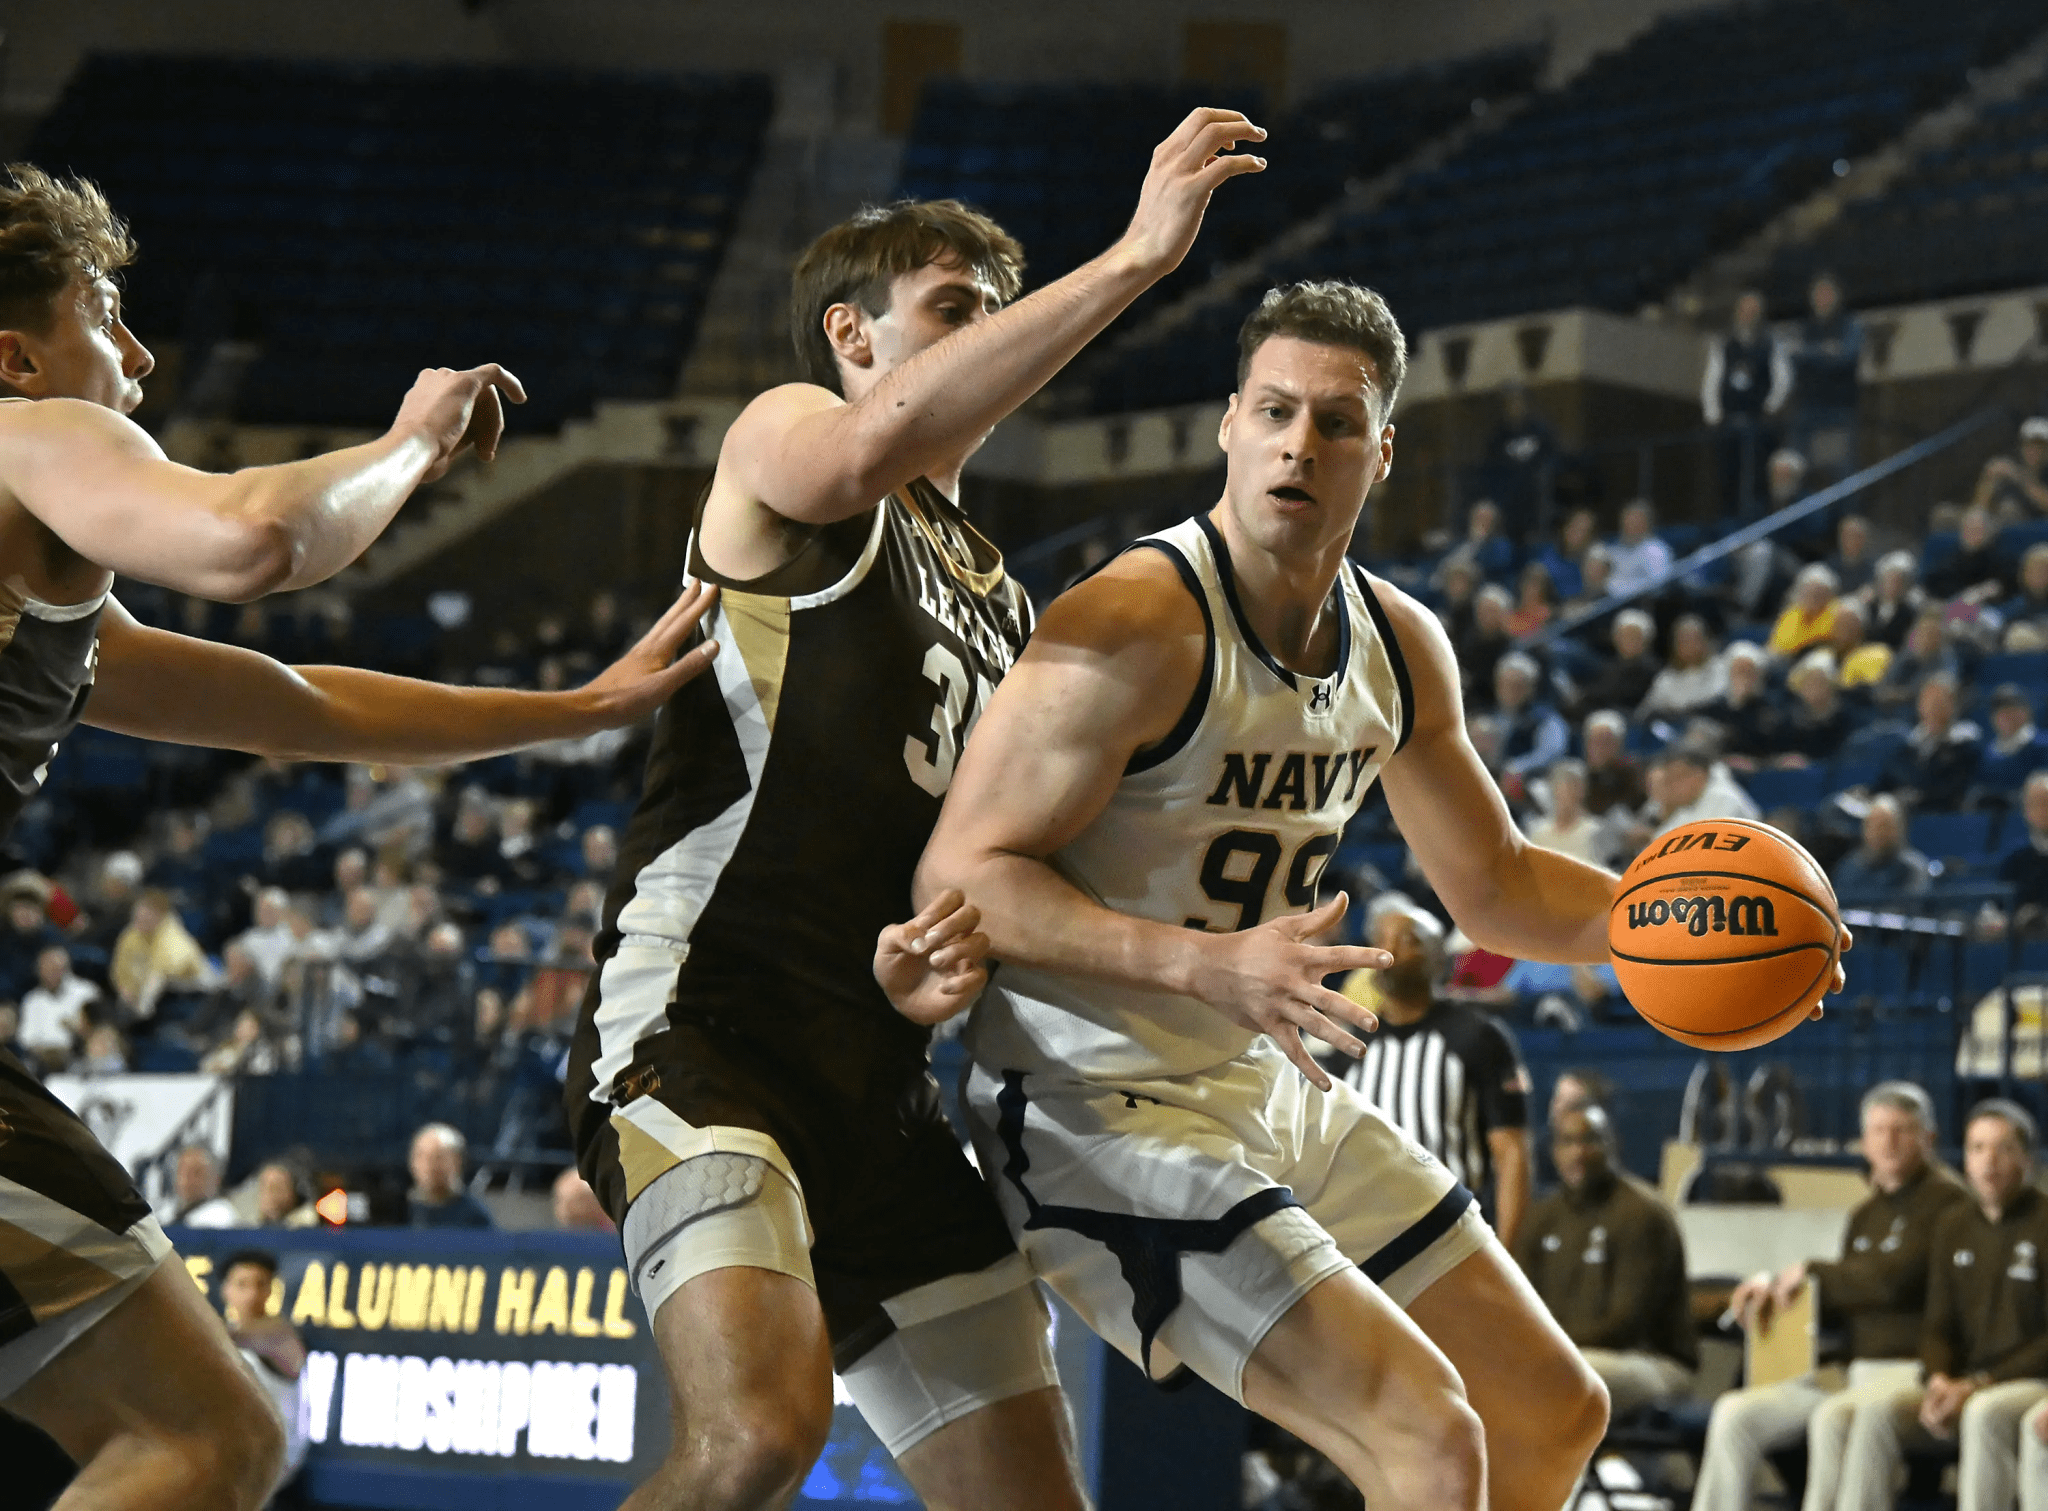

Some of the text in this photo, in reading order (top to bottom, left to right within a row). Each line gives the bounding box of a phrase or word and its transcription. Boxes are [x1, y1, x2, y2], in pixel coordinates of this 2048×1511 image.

[1205, 745, 1379, 809] NAVY
[1657, 832, 1751, 857] EVO
[1627, 894, 1779, 937] Wilson
[291, 1258, 488, 1335] ALUMNI
[494, 1265, 638, 1340] HALL
